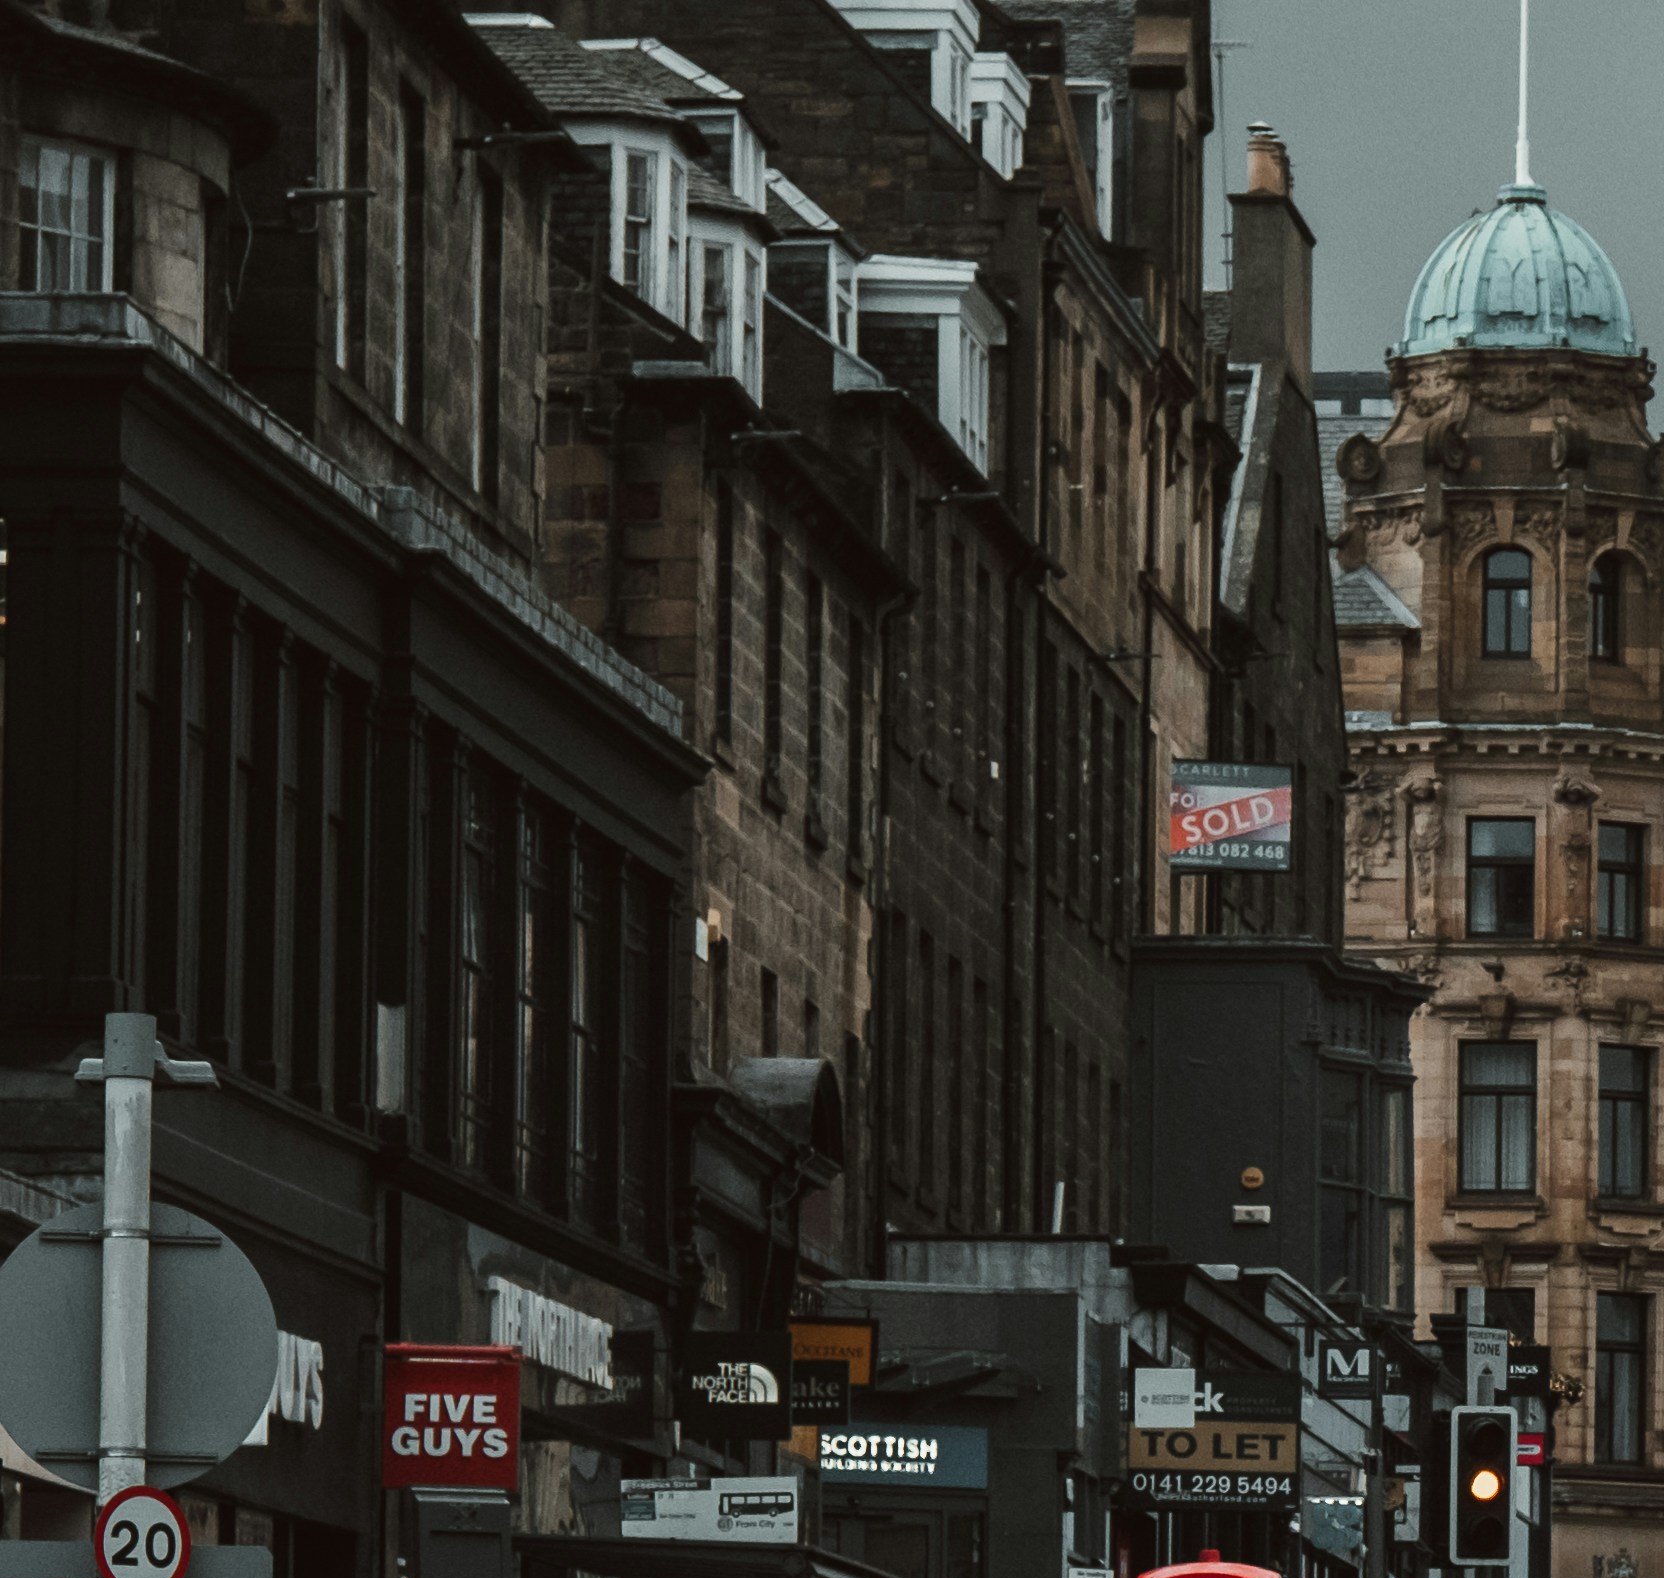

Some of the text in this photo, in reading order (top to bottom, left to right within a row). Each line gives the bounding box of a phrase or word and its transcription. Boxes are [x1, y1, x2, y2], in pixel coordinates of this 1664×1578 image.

[1180, 797, 1275, 843] SOLD
[1219, 842, 1250, 858] 082
[1254, 845, 1285, 861] 468
[1473, 1342, 1501, 1356] ZONE
[717, 1362, 748, 1377] THE
[691, 1375, 748, 1390] NORTH
[793, 1377, 841, 1397] ake
[707, 1389, 748, 1404] FACE
[403, 1393, 498, 1424] FIVE
[391, 1426, 510, 1459] GUYS
[820, 1434, 939, 1460] SCOTTISH
[1140, 1430, 1286, 1461] TO LET
[820, 1458, 878, 1472] UILDING
[1132, 1473, 1292, 1496] 0141 229 5494
[110, 1519, 177, 1569] 20
